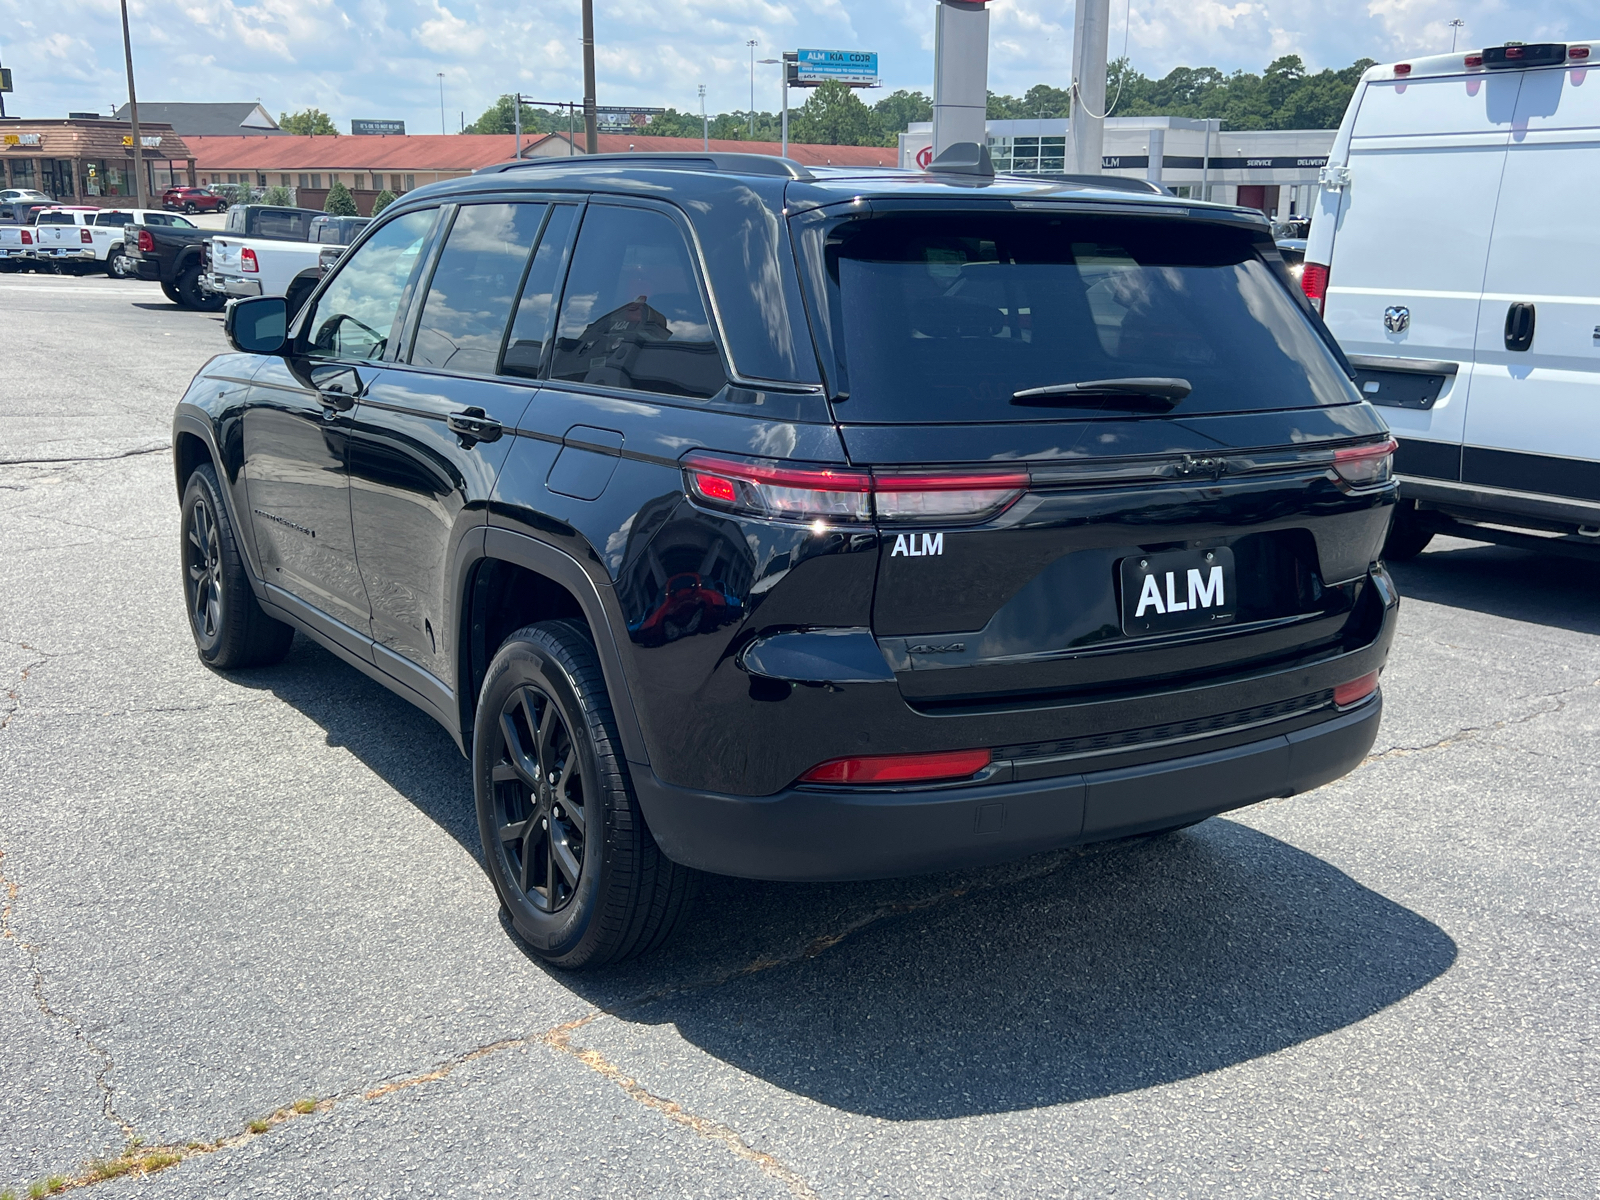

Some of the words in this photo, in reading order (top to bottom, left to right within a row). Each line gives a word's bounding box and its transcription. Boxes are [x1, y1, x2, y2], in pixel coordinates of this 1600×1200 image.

[807, 52, 825, 60] ALM
[829, 53, 844, 61] KIA
[849, 54, 871, 62] CDJR
[4, 133, 41, 145] SUBWAY
[122, 136, 162, 147] SUWAY
[1246, 159, 1272, 167] SERVICE
[891, 532, 944, 557] ALM
[1134, 565, 1225, 617] ALM
